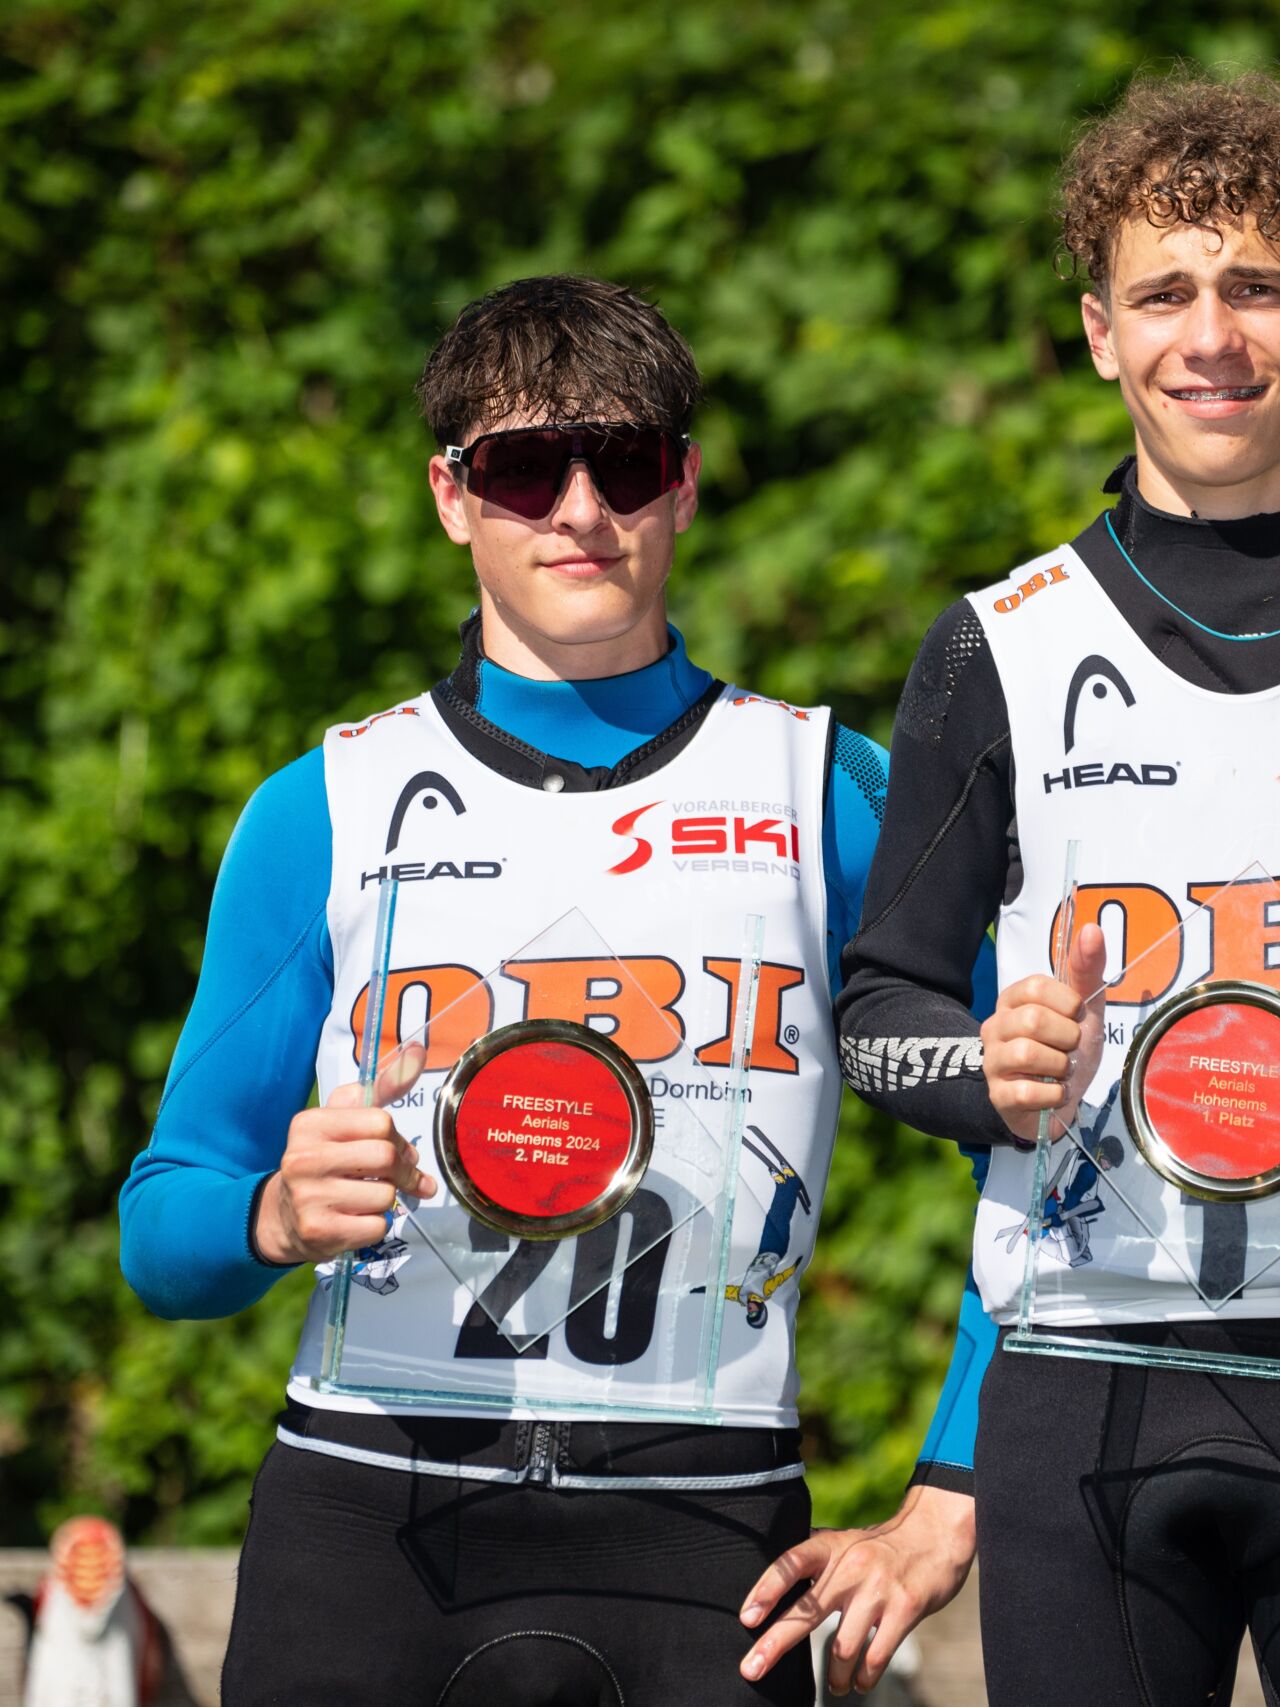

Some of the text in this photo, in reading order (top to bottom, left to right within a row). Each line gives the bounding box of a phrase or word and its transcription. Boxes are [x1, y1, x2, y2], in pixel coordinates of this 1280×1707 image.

[993, 563, 1070, 614] OBI
[1043, 763, 1177, 794] HEAD
[672, 800, 798, 822] VORARLBERGER
[672, 816, 800, 864] SKI
[361, 861, 502, 891] HEAD
[673, 859, 800, 881] VERBAND
[349, 955, 805, 1076] OBI
[1189, 1055, 1279, 1078] FREESTYLE
[650, 1077, 752, 1103] Dornbirn
[1208, 1075, 1256, 1093] Aerials
[503, 1094, 593, 1115] FREESTYLE
[1193, 1091, 1268, 1112] Hohenems
[521, 1114, 570, 1131] Aerials
[1202, 1109, 1255, 1128] 1. Platz
[487, 1128, 601, 1151] Hohenems 2024
[515, 1148, 569, 1166] 2. Platz
[454, 1187, 673, 1366] 20
